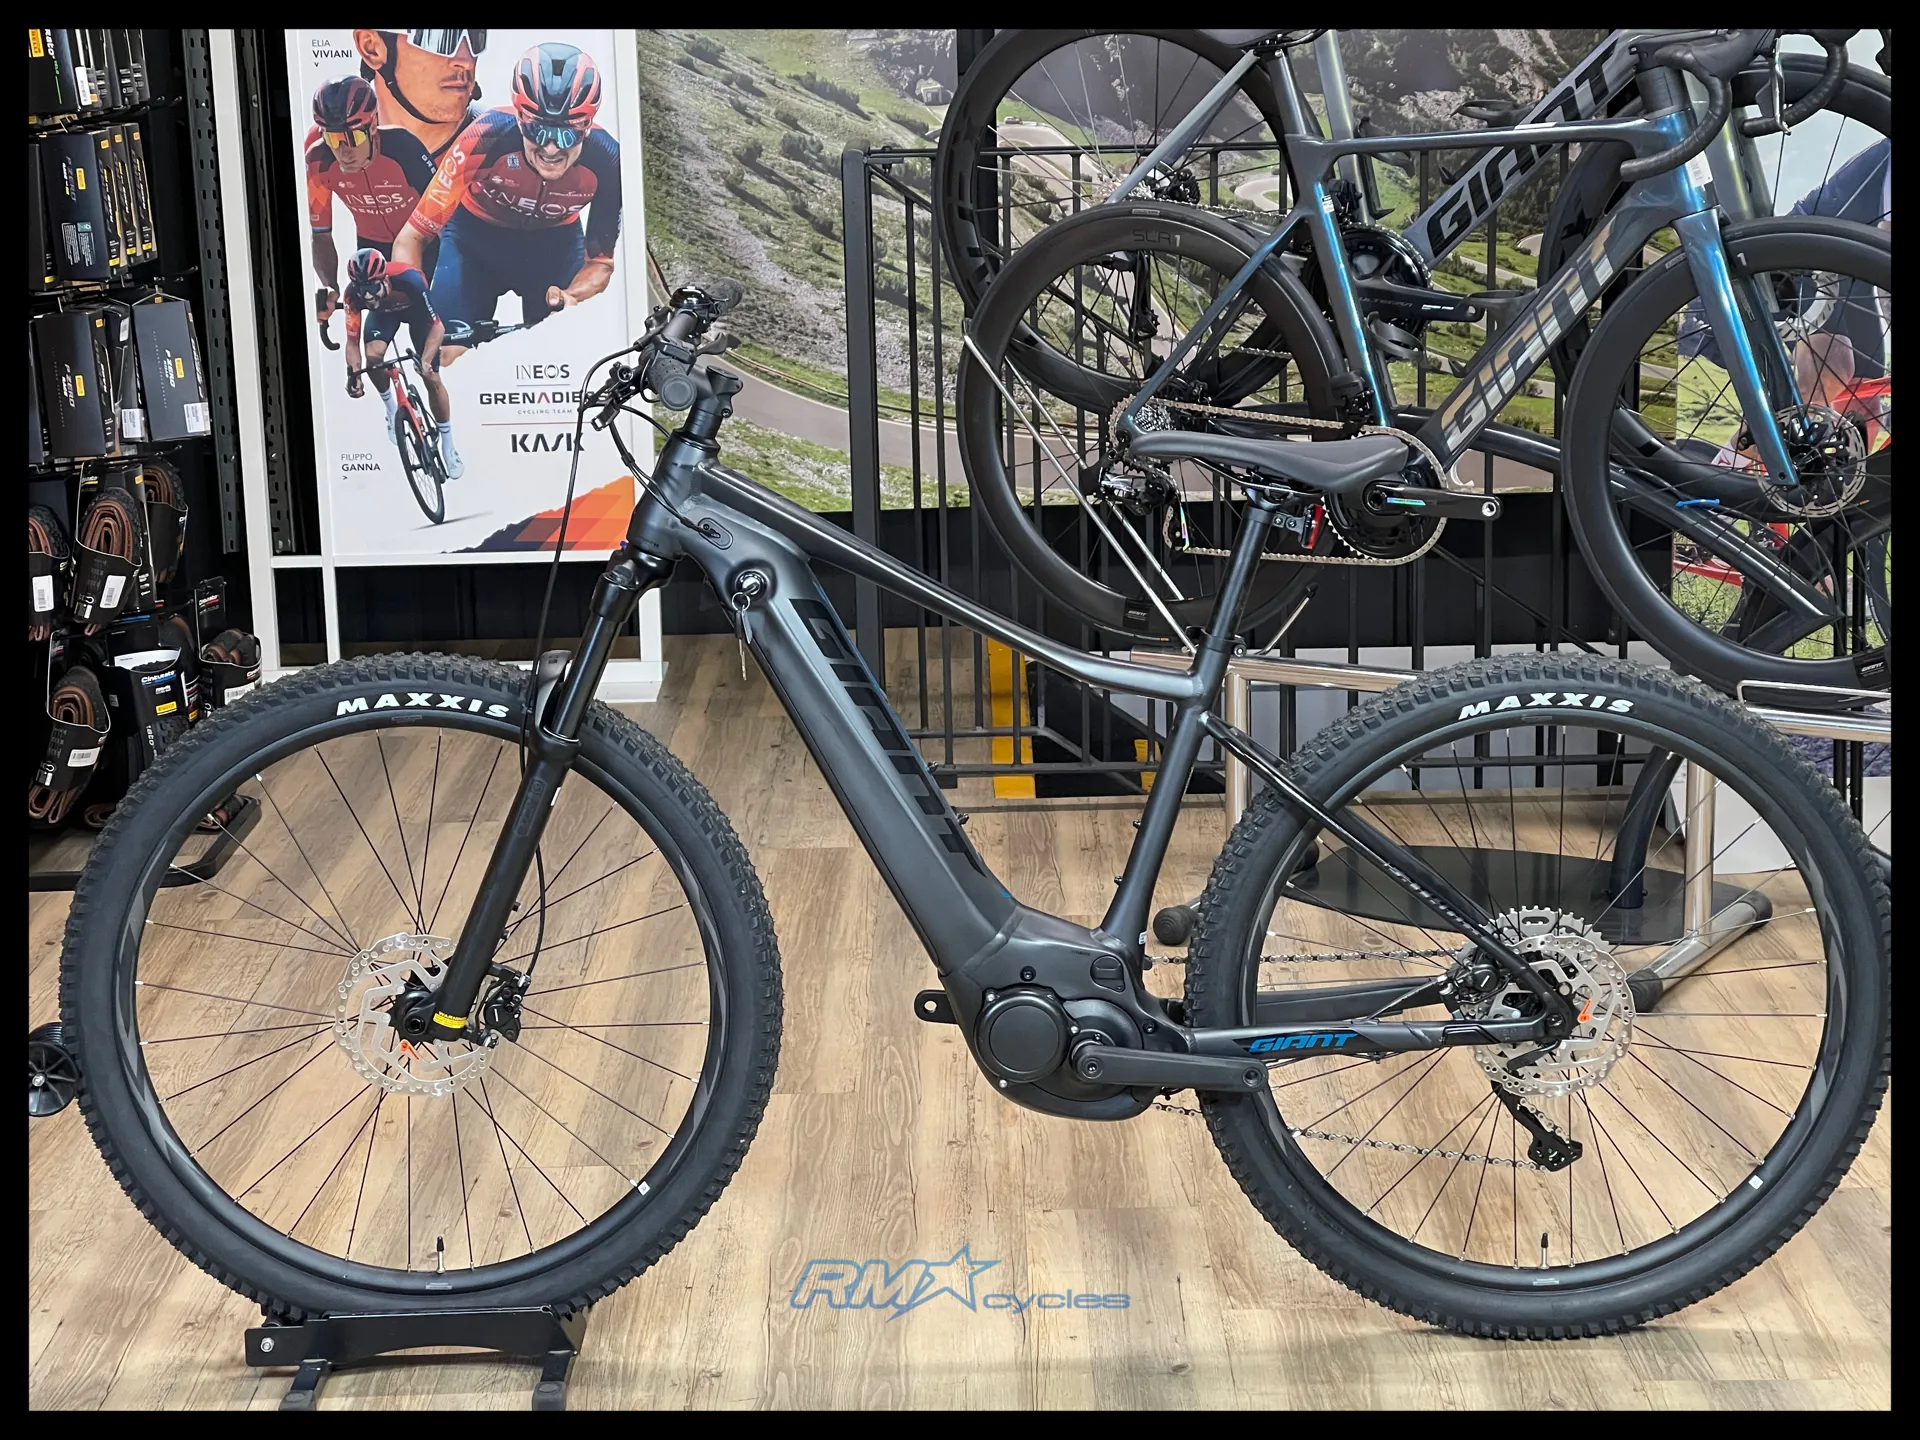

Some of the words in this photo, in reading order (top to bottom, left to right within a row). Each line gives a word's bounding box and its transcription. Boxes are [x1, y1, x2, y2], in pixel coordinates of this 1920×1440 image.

[311, 39, 331, 47] ELIA
[312, 49, 353, 58] VIVIANI
[428, 143, 466, 209] INEOS
[345, 193, 404, 205] INEOS
[1441, 212, 1615, 452] GIANT
[516, 364, 571, 380] INEOS
[340, 453, 373, 461] FILIPPO
[341, 463, 381, 472] GANNA
[336, 692, 511, 718] MAXXIS
[1457, 692, 1635, 721] MAXXIS
[1248, 1033, 1359, 1053] GIANT
